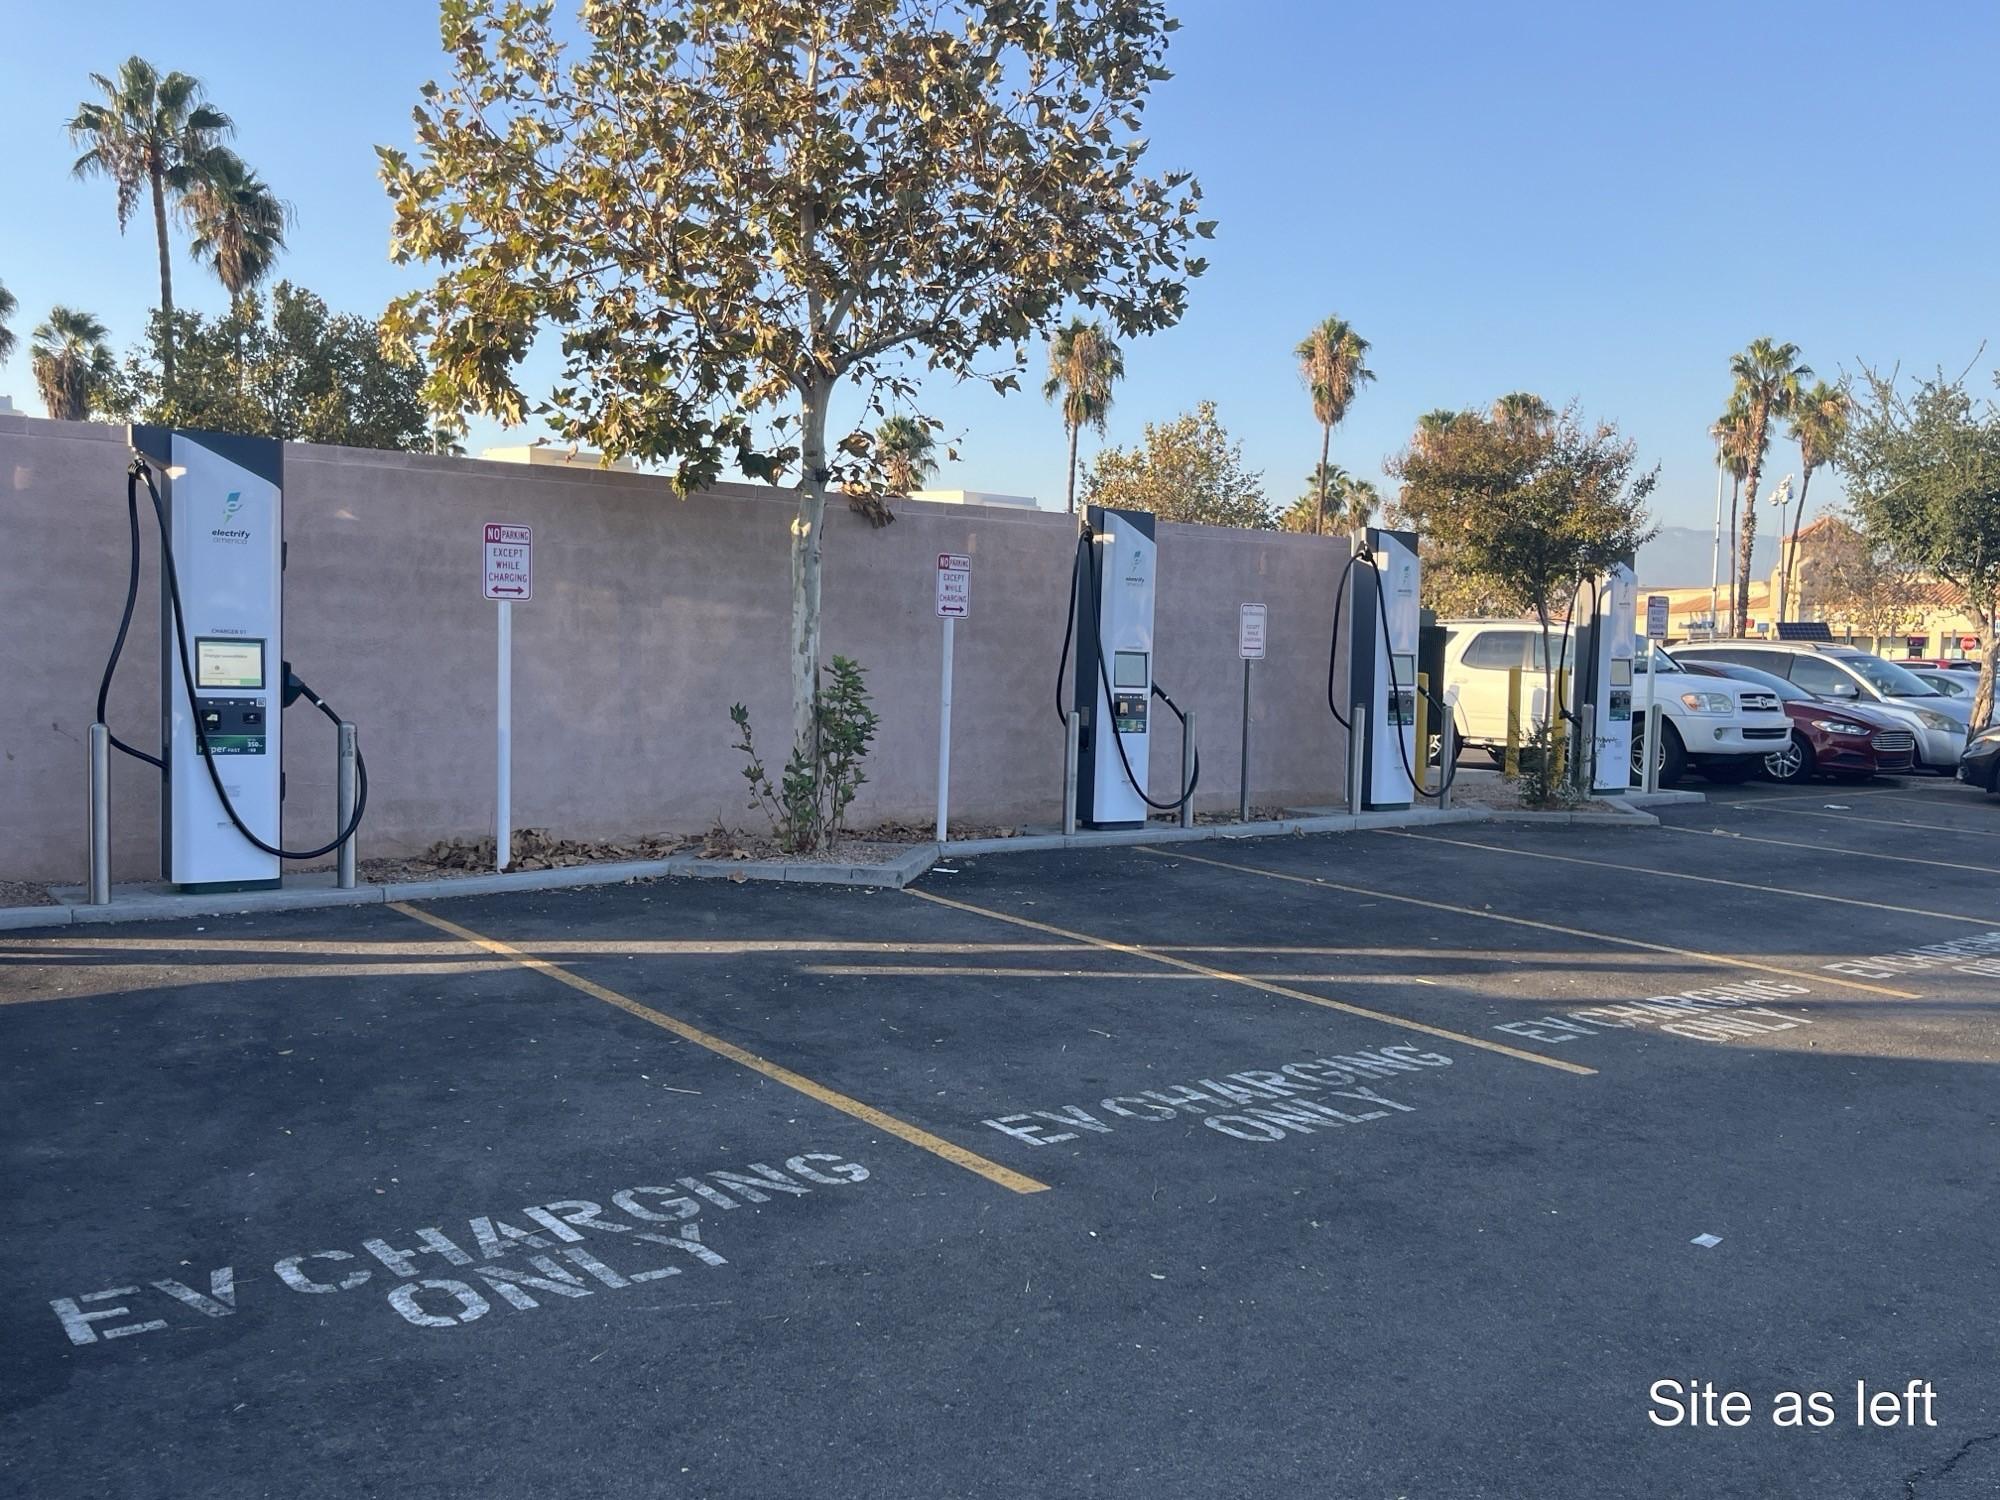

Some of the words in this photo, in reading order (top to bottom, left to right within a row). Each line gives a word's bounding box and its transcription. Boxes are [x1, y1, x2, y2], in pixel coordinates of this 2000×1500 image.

[211, 529, 250, 540] electrify
[487, 527, 501, 540] NO
[502, 530, 529, 541] PARKING
[493, 547, 524, 558] EXCEPT
[496, 561, 520, 570] WHILE
[939, 556, 949, 568] NO
[950, 559, 969, 568] PARKING
[488, 572, 528, 583] CHARGING
[943, 573, 965, 582] EXCEPT
[945, 584, 962, 592] WHILE
[940, 594, 967, 603] CHARGING
[1493, 1016, 1600, 1043] EV
[1567, 980, 1810, 1029] CHARGING
[1659, 1007, 1813, 1043] ONLY
[982, 1105, 1115, 1146] EV
[1101, 1045, 1453, 1122] CHARGING
[1203, 1086, 1416, 1142] ONLY
[49, 1266, 238, 1346] EV
[273, 1152, 871, 1294] CHARGING
[387, 1223, 729, 1328] ONLY
